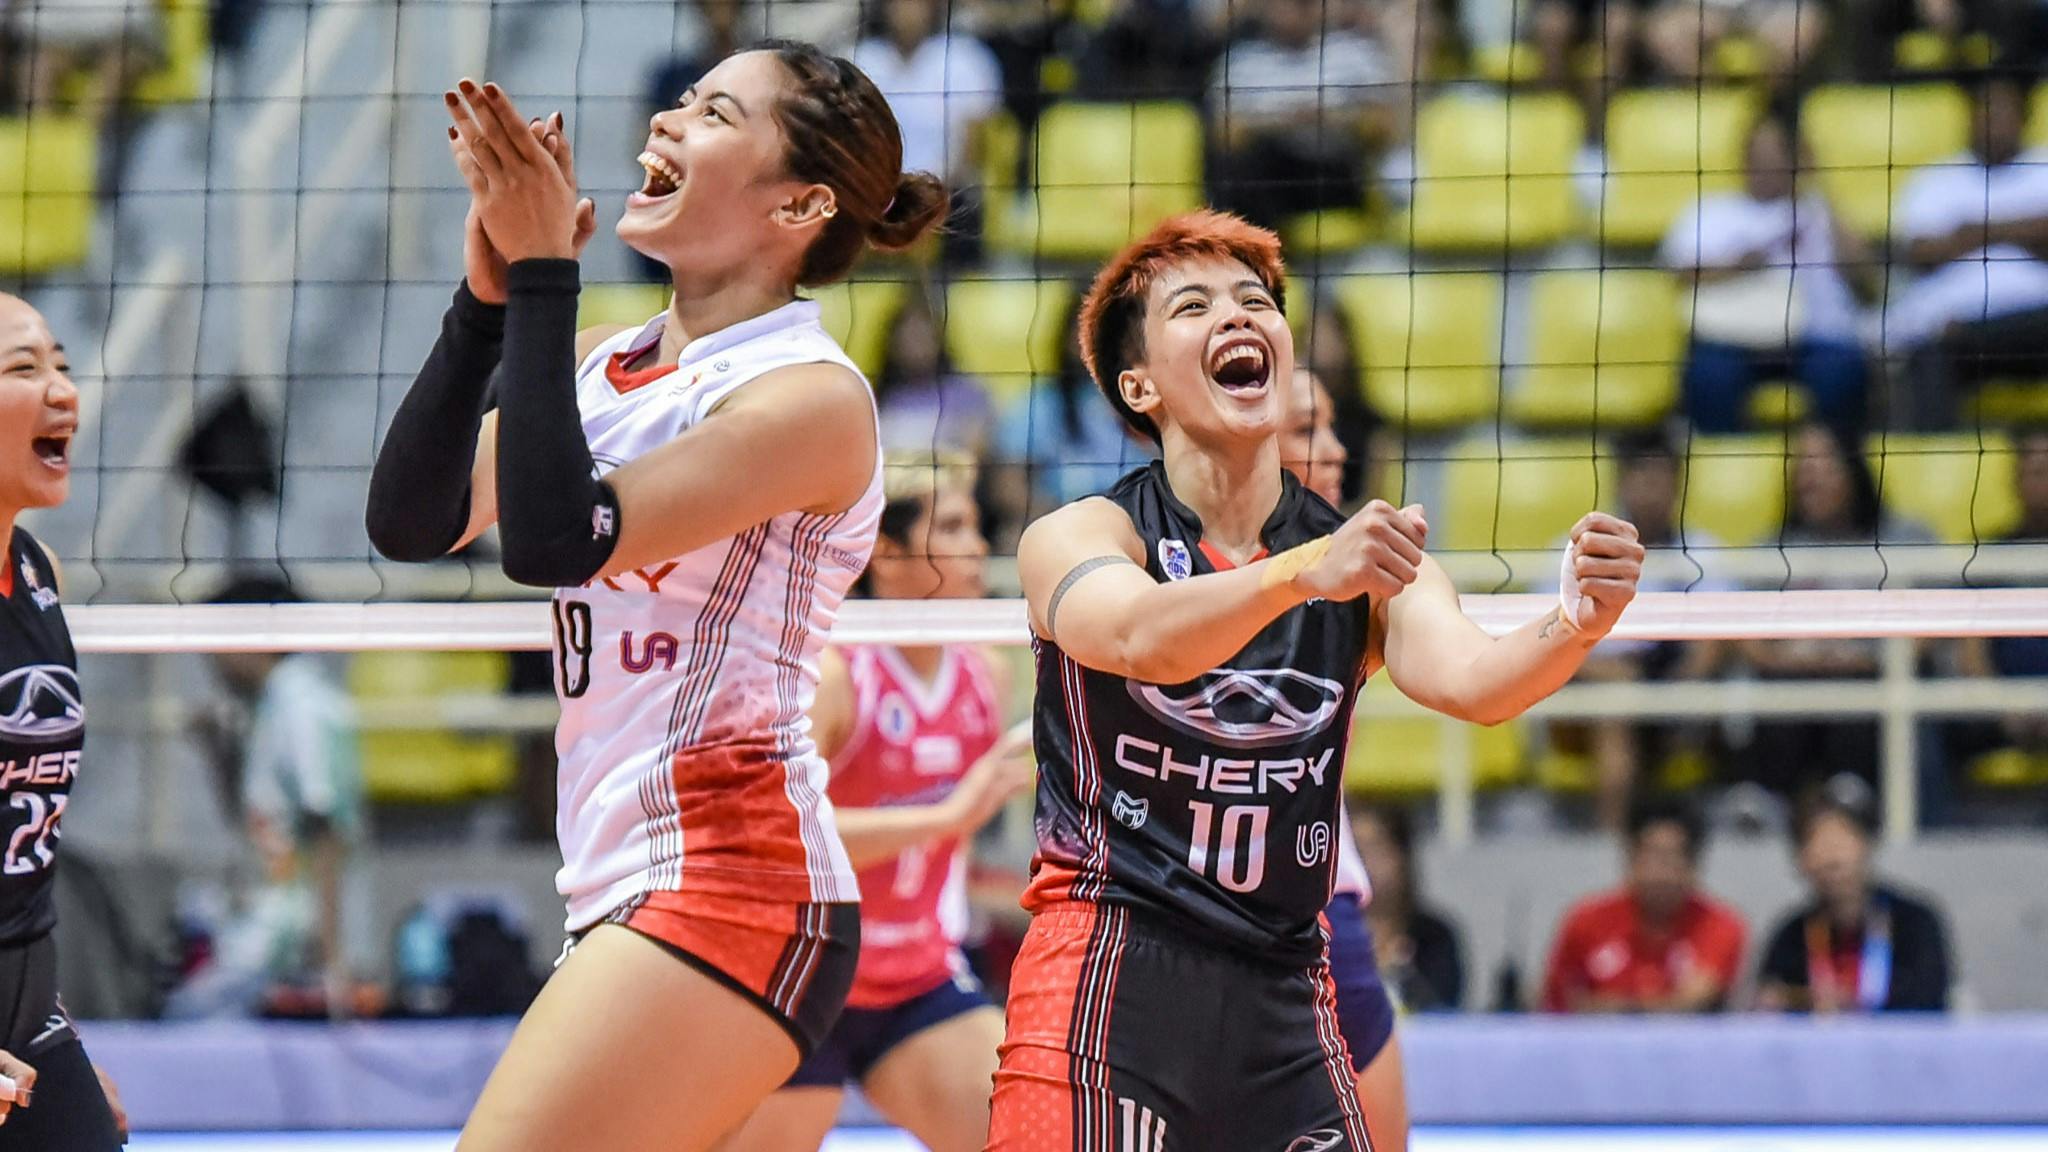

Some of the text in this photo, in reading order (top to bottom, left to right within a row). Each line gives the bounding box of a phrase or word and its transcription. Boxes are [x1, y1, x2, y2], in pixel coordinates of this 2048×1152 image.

[0, 750, 81, 790] HER
[1115, 733, 1335, 795] CHERY
[1187, 800, 1269, 893] 10
